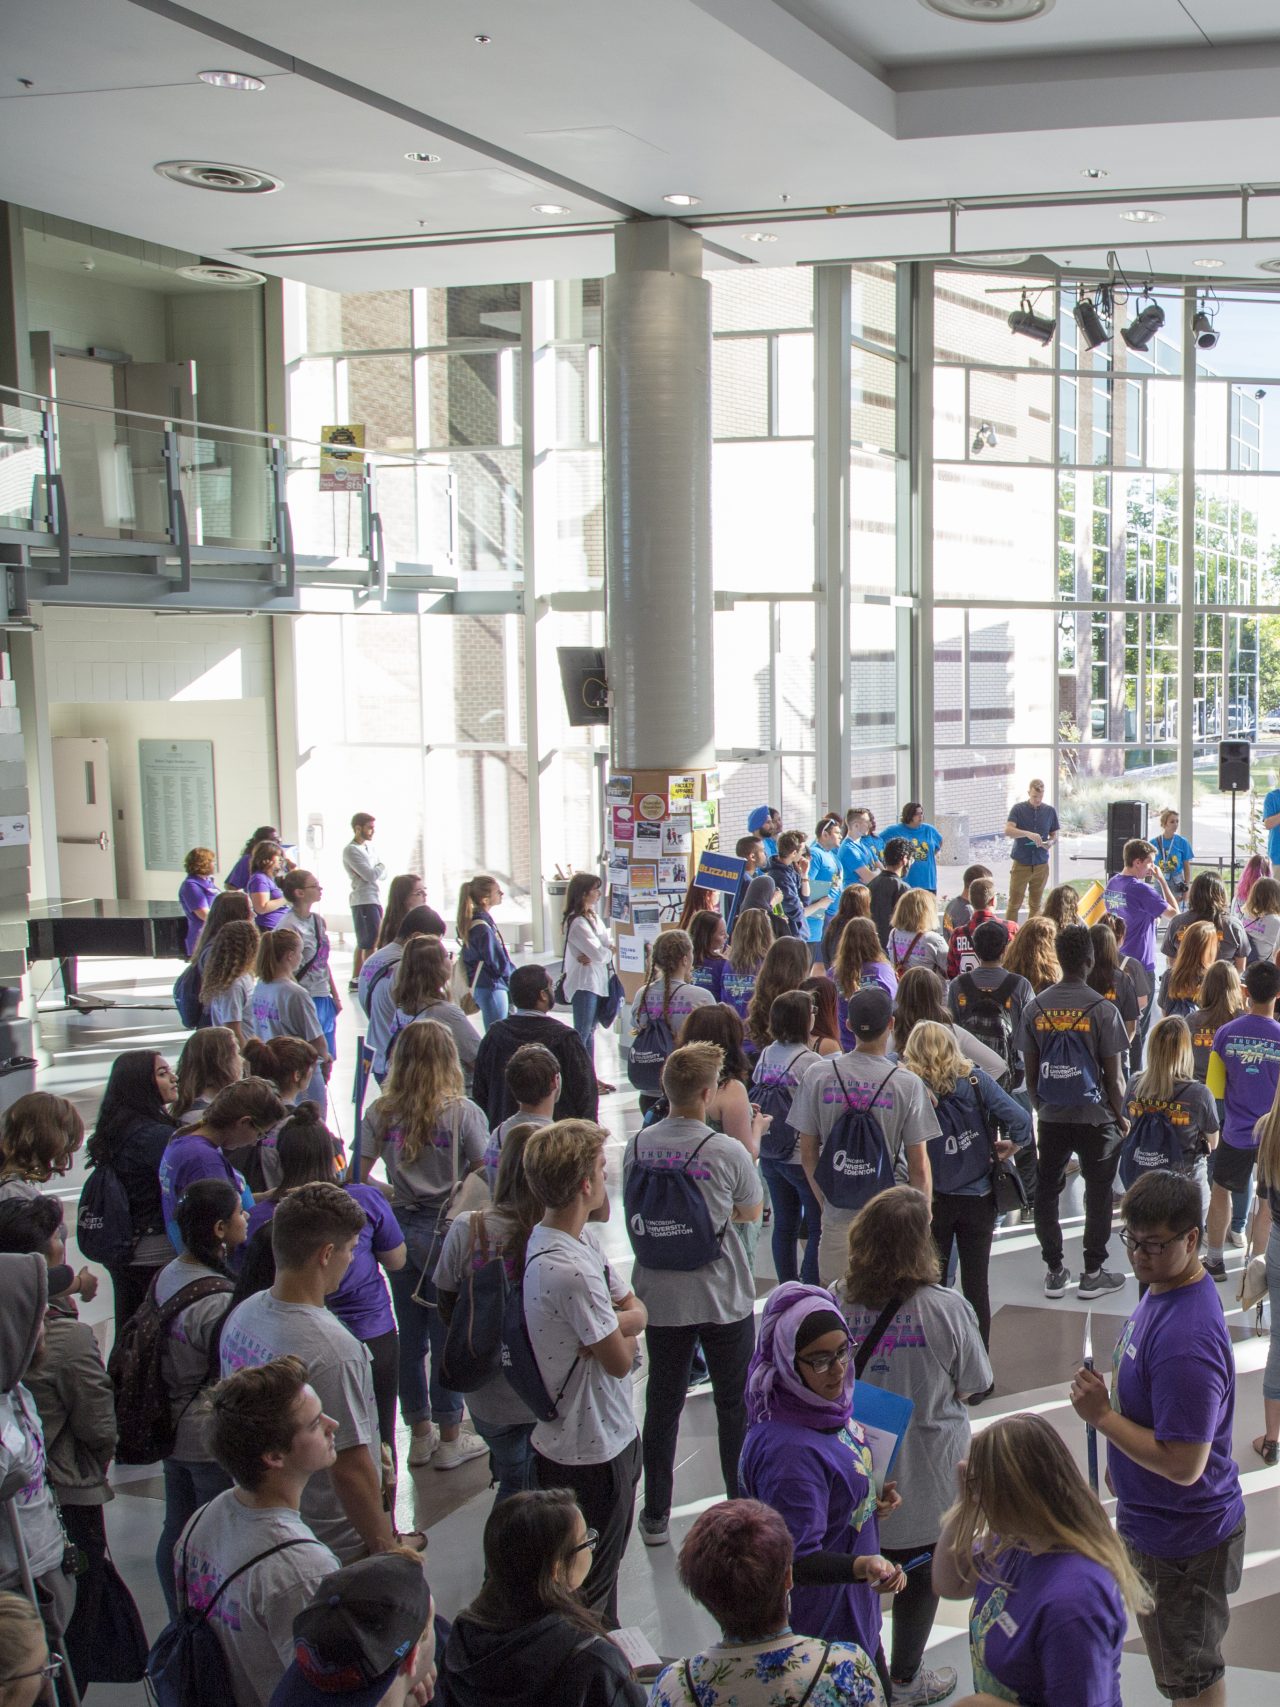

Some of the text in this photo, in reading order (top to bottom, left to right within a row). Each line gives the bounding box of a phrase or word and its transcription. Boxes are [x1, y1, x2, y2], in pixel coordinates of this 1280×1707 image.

[698, 864, 739, 880] BLIZZARD
[1234, 1038, 1275, 1049] THUNDER
[1240, 1054, 1264, 1064] 2017
[833, 1080, 884, 1090] TUNDE
[845, 1315, 912, 1326] THUER
